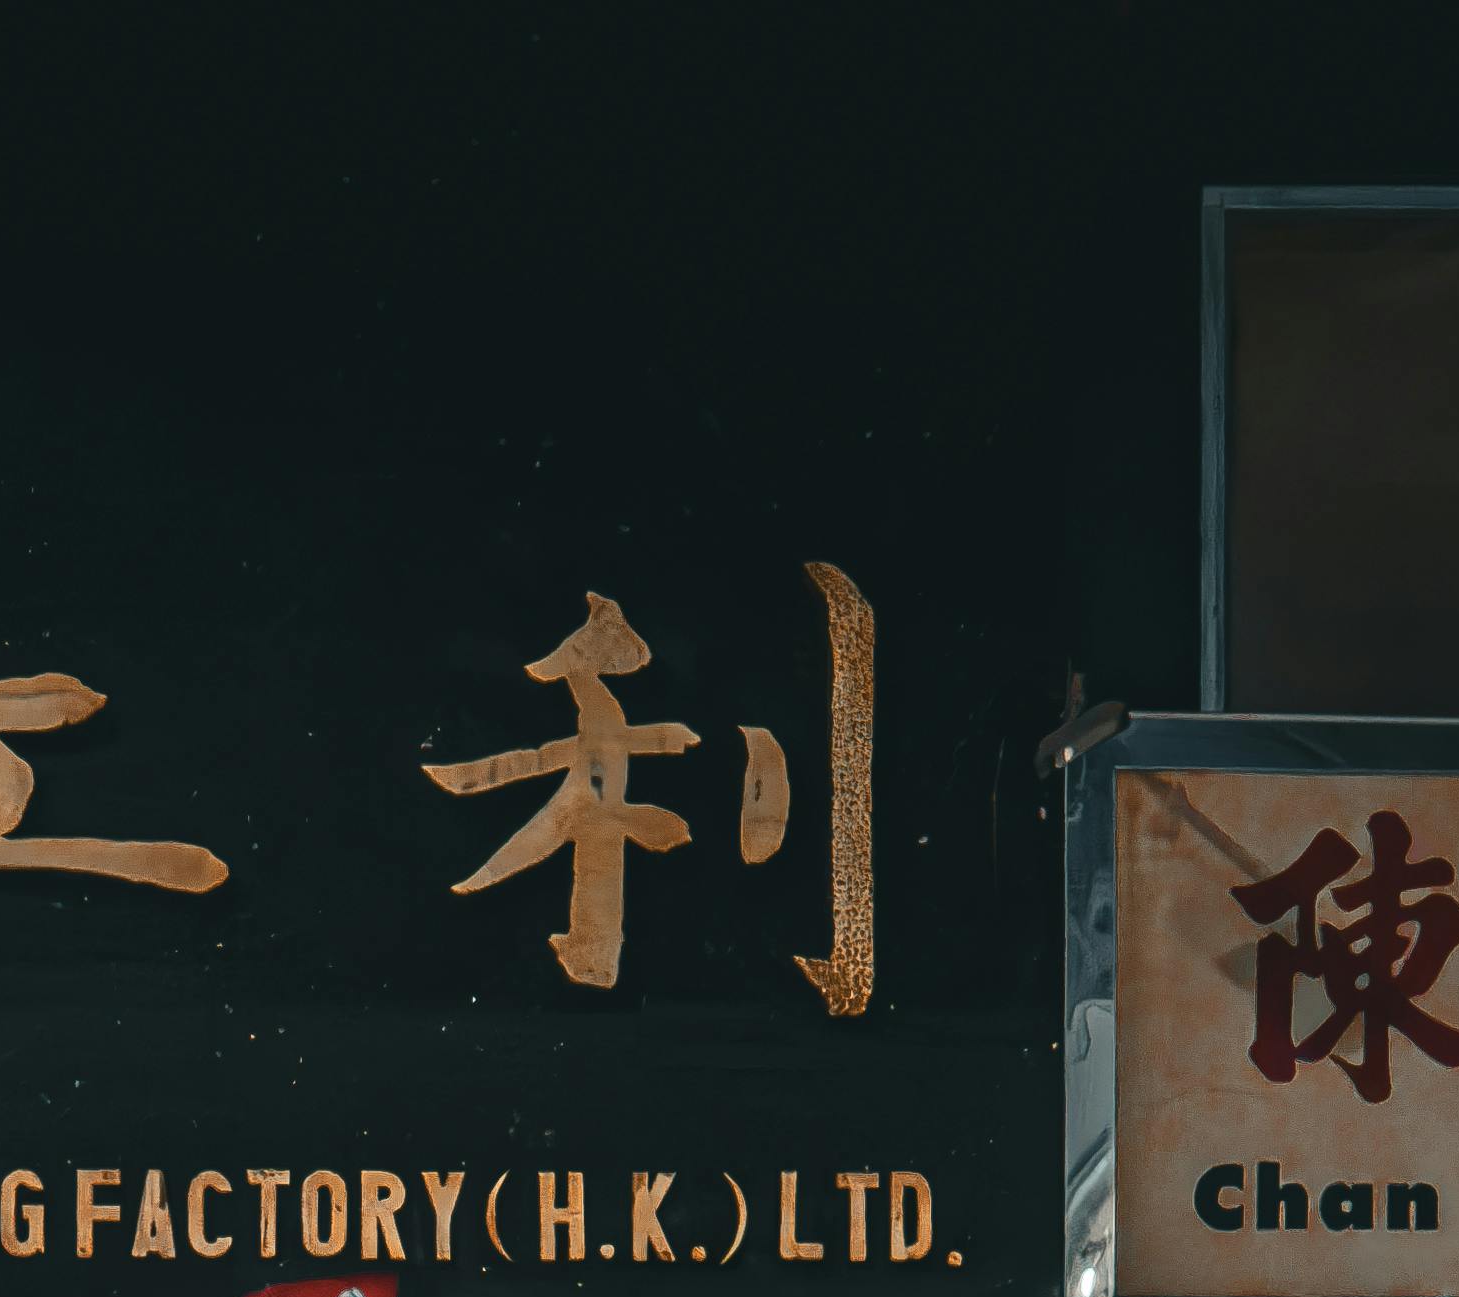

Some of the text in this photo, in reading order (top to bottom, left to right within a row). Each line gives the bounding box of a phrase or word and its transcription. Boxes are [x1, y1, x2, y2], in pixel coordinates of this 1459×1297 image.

[75, 1168, 465, 1262] FACTORY
[778, 1170, 964, 1268] LTD.
[1193, 1161, 1440, 1233] Chan
